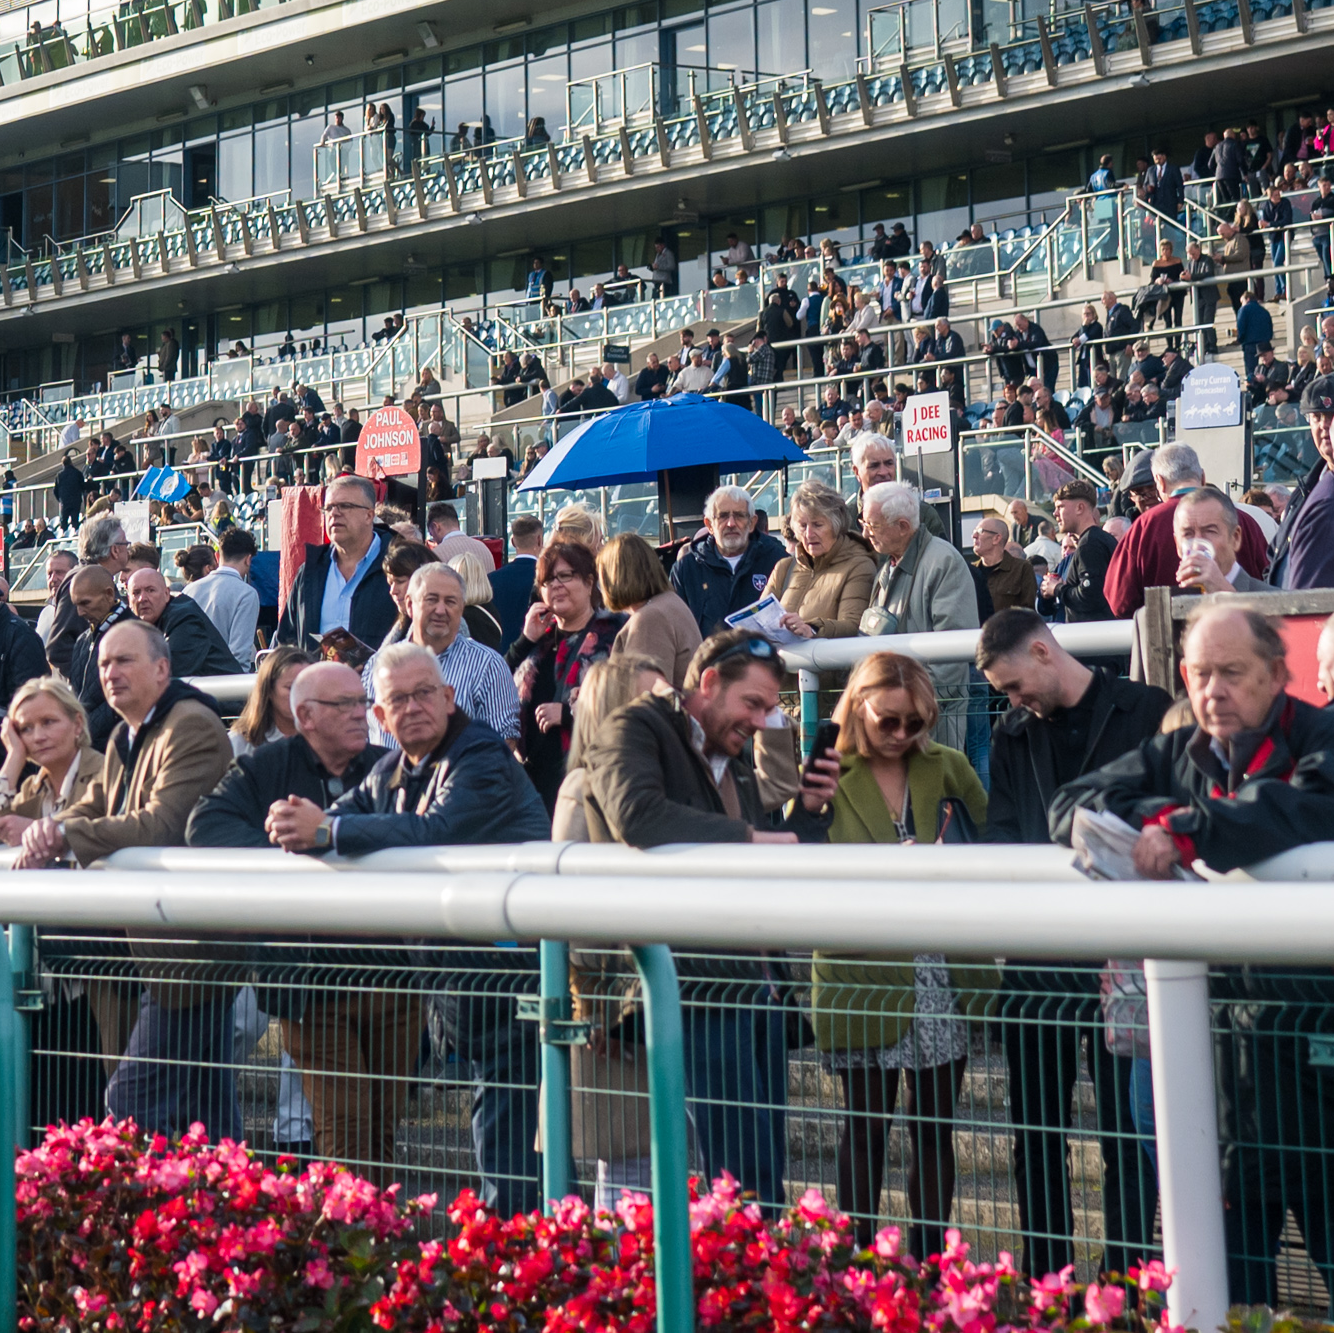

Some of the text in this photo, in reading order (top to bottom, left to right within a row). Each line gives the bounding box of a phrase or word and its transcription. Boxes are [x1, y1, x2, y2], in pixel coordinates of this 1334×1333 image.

[1190, 375, 1231, 387] Barry Curran
[1194, 386, 1227, 396] (Doncaster)
[375, 410, 403, 428] PAUL
[913, 404, 940, 426] J DEE
[363, 429, 414, 450] JOHNSON
[907, 424, 948, 444] RACING
